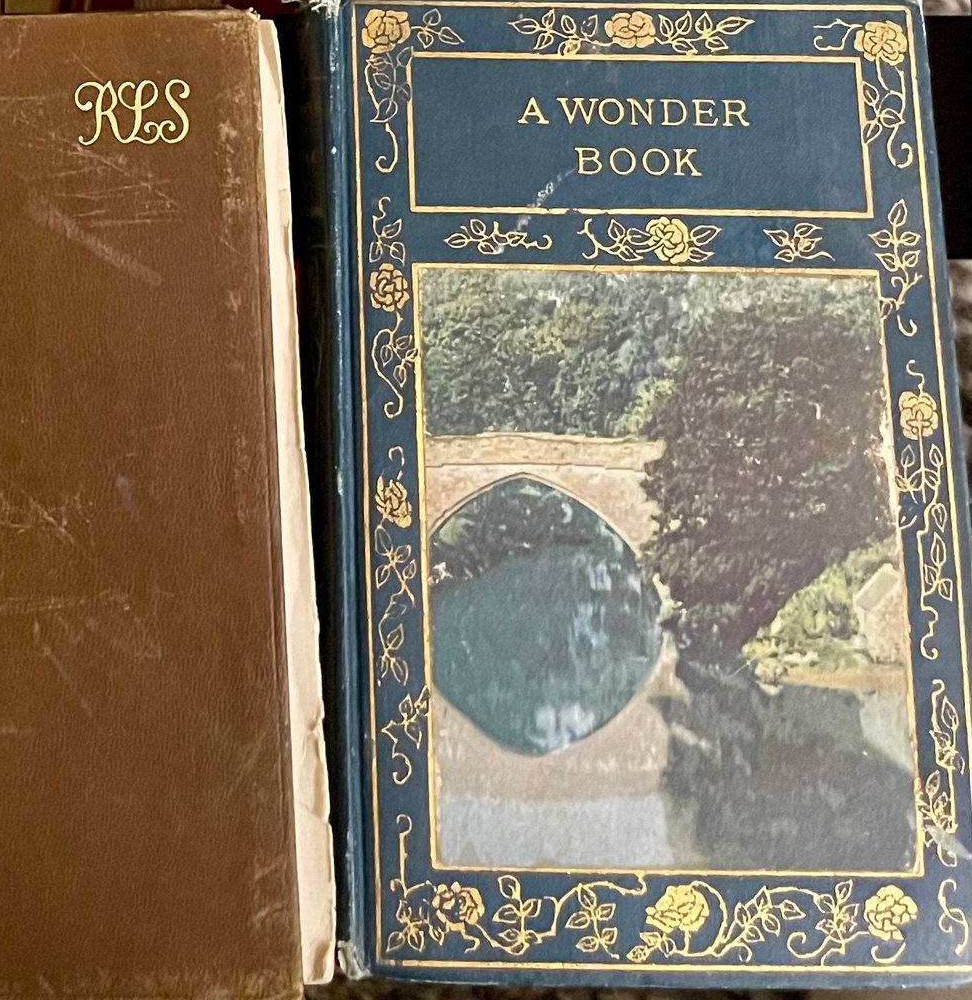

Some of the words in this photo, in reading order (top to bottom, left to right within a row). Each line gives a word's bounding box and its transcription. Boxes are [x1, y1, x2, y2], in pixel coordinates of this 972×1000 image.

[74, 79, 191, 146] RLS
[518, 97, 549, 125] A
[556, 98, 750, 127] WONDER
[574, 147, 702, 177] BOOK
